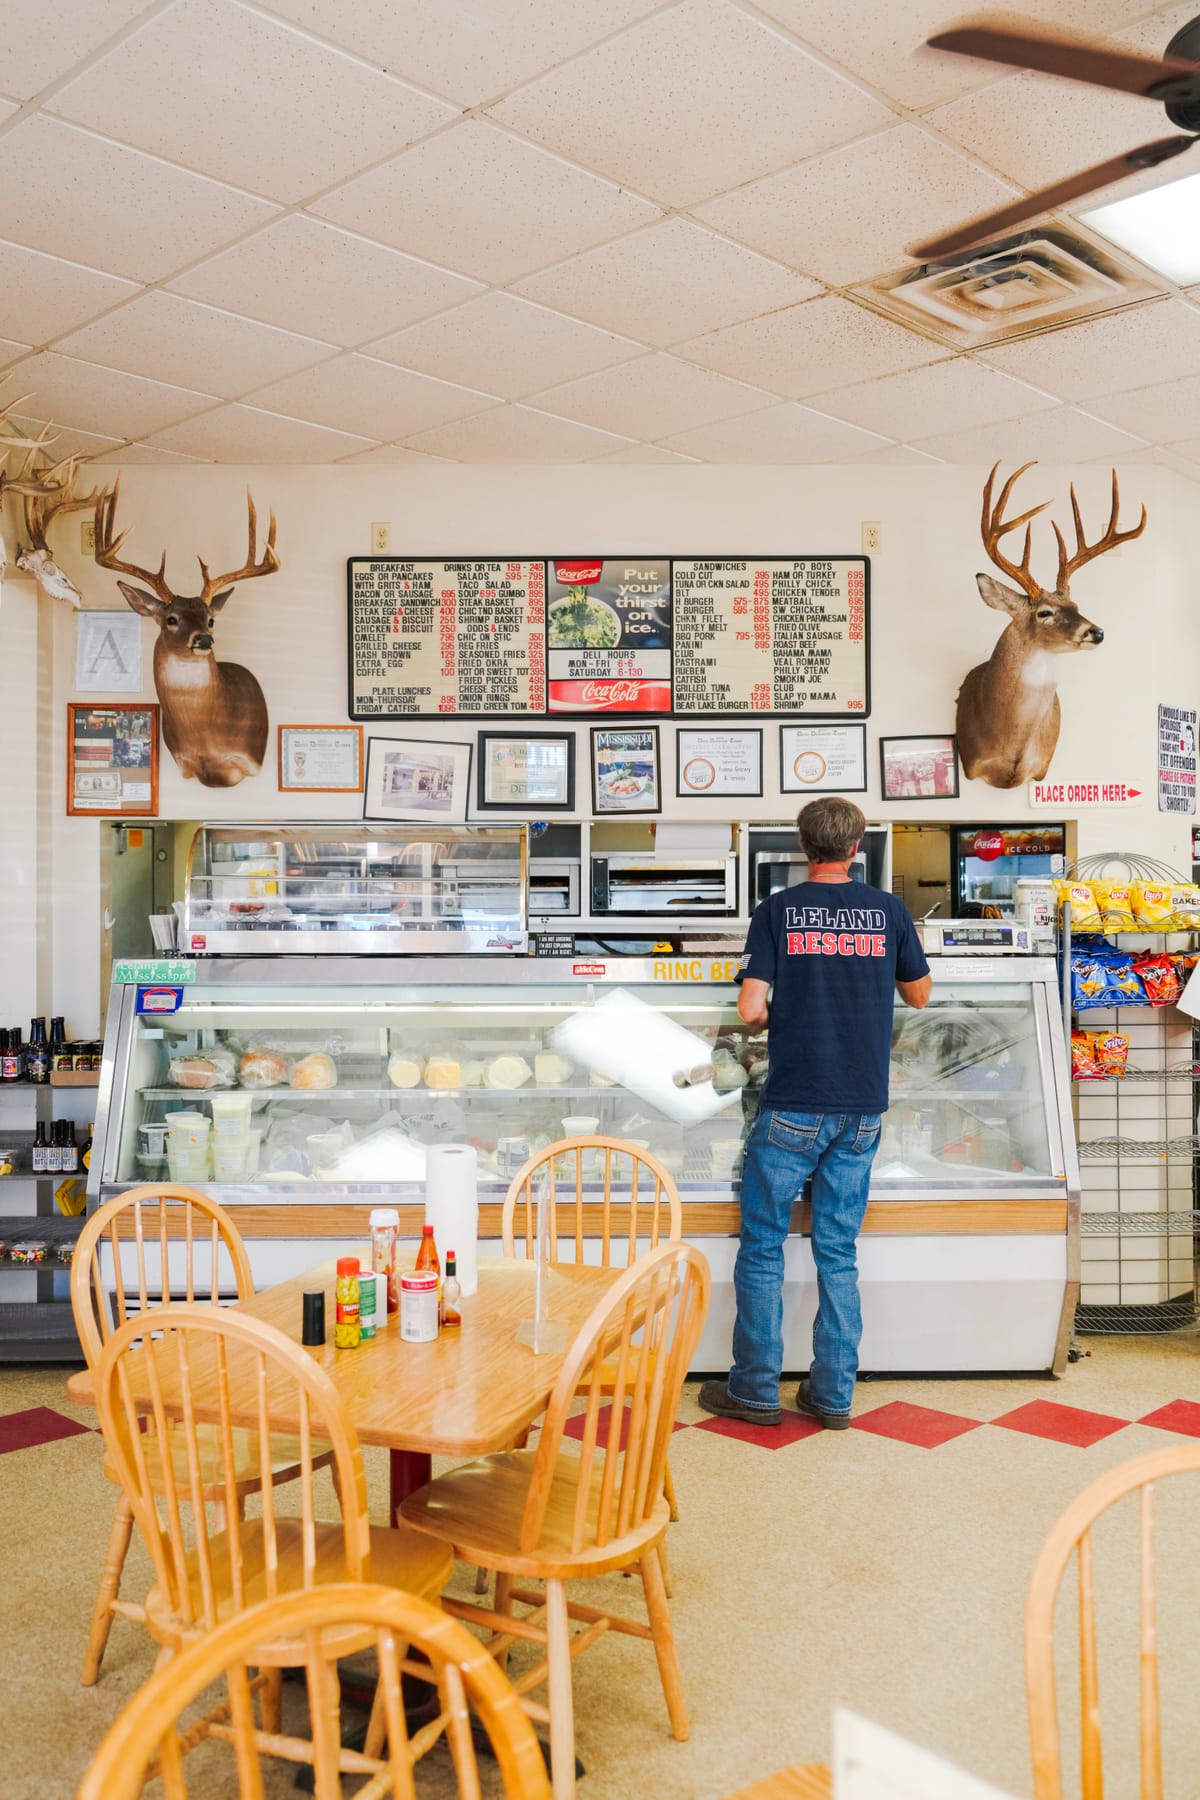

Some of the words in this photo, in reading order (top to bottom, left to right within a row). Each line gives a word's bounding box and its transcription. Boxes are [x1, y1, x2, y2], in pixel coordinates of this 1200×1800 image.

[557, 568, 601, 580] Coca-Cola
[624, 568, 658, 580] Put
[618, 584, 662, 596] your
[616, 598, 666, 608] thirst
[628, 612, 652, 620] on
[625, 622, 656, 633] ice.
[88, 629, 130, 674] A
[582, 681, 640, 701] Coca-Cola
[1180, 710, 1189, 722] LIKE
[1190, 712, 1196, 724] TO
[1160, 754, 1168, 766] YET
[1170, 755, 1196, 770] OFFENDED
[1160, 770, 1173, 782] PLEASE
[1174, 772, 1179, 782] BE
[1180, 772, 1196, 784] PATIENT
[1035, 785, 1064, 802] PLACE
[1068, 785, 1099, 802] ORDER
[1102, 785, 1126, 801] HERE
[1167, 796, 1188, 811] SHORTLY
[974, 838, 1002, 849] Coca-Cola
[786, 907, 886, 930] LELAND
[786, 932, 886, 956] RESCUE
[654, 961, 702, 981] RING
[1072, 963, 1099, 974] Doritos
[1104, 1038, 1127, 1050] Fritos
